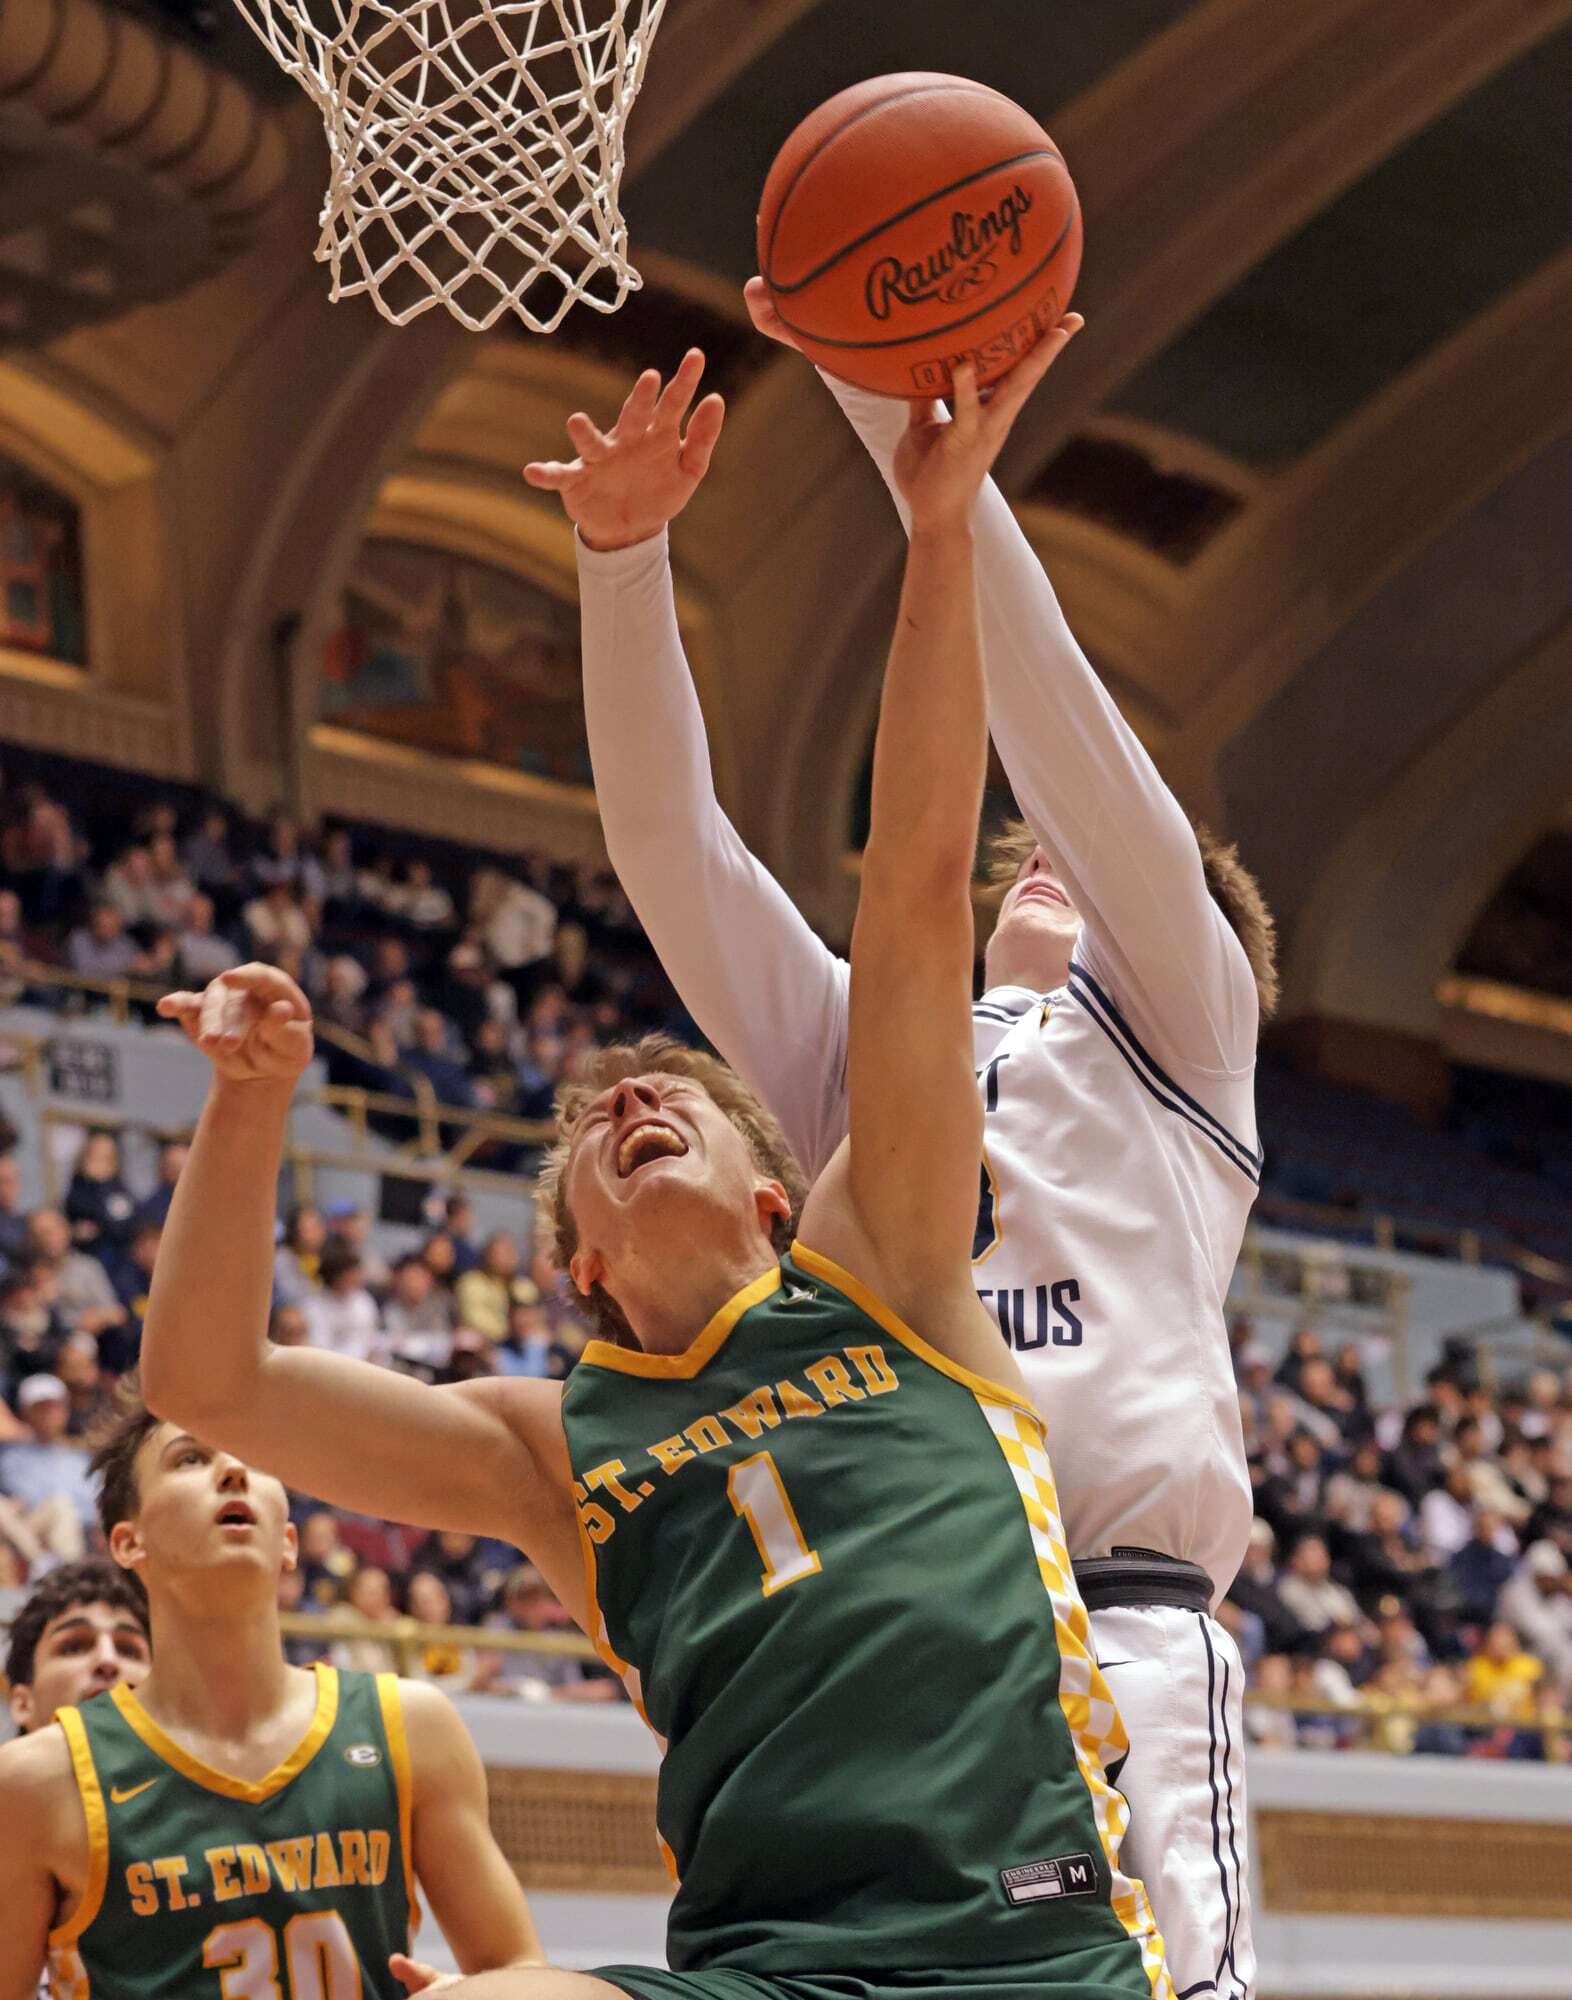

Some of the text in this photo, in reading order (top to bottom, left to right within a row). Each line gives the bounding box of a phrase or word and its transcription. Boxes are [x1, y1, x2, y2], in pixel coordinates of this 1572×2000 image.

[866, 185, 1032, 320] Rawlings
[573, 1345, 900, 1544] ST. EDWARD
[727, 1450, 824, 1598] 1
[126, 1830, 390, 1916] ST. EDWARD
[1068, 1864, 1087, 1884] M
[202, 1909, 364, 2000] 30
